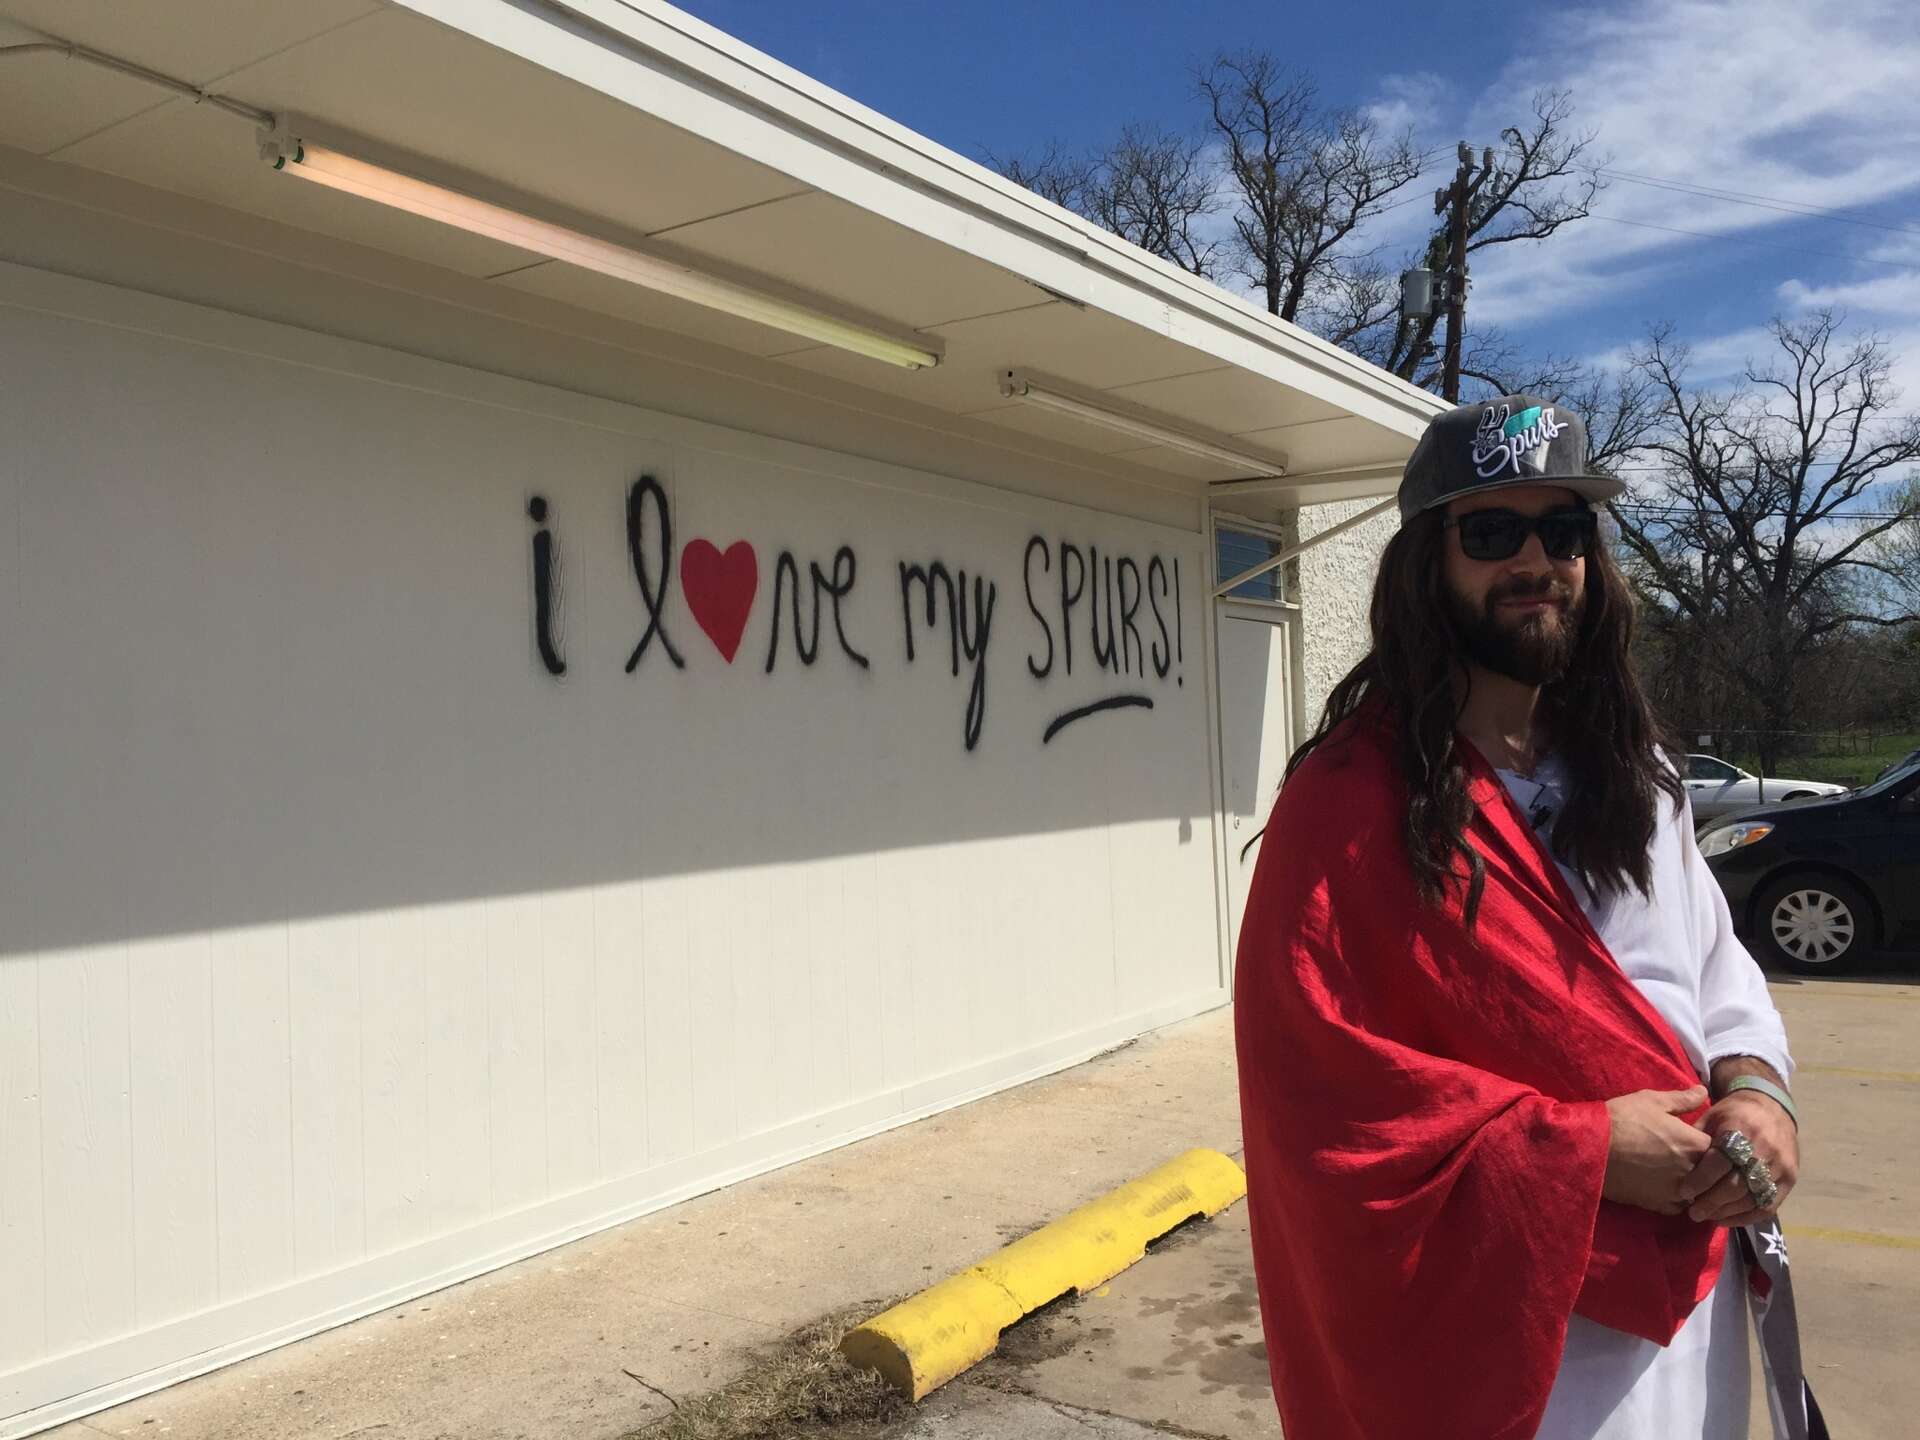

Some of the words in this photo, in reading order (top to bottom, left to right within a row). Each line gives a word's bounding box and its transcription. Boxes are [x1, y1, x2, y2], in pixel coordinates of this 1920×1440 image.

[1472, 407, 1569, 477] Spurs
[529, 496, 566, 674] i
[900, 561, 995, 751] my
[1024, 535, 1184, 688] SPURS!
